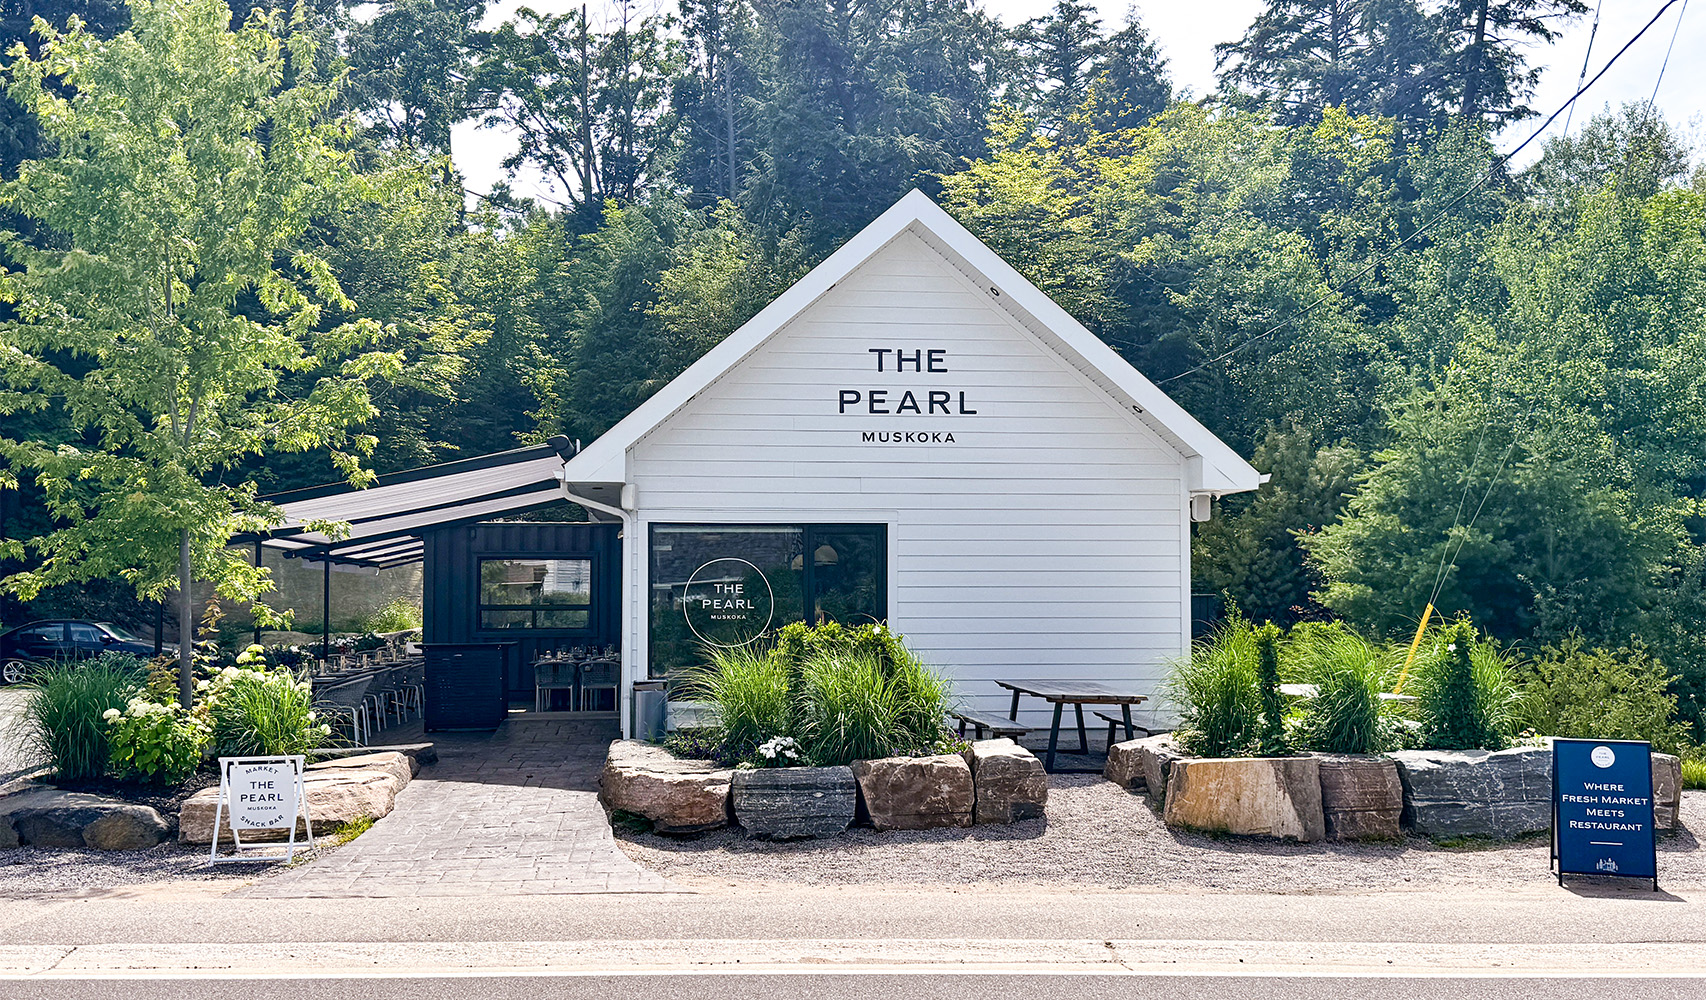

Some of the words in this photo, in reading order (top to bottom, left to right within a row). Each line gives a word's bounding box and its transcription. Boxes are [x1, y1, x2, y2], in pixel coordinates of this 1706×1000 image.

[869, 349, 948, 372] THE
[839, 390, 977, 414] PEARL
[862, 432, 955, 443] MUSKOKA
[714, 583, 744, 594] THE
[702, 599, 755, 609] PEARL
[245, 766, 279, 774] MARKET
[249, 781, 275, 789] THE
[1583, 782, 1625, 792] WHERE
[240, 793, 284, 802] PEARL
[1562, 794, 1598, 804] FRESH
[1601, 796, 1648, 806] MARKET
[1586, 808, 1625, 817] MEETS
[240, 815, 266, 827] SNACK
[268, 814, 284, 826] BAR
[1569, 820, 1643, 832] RESTAURANT
